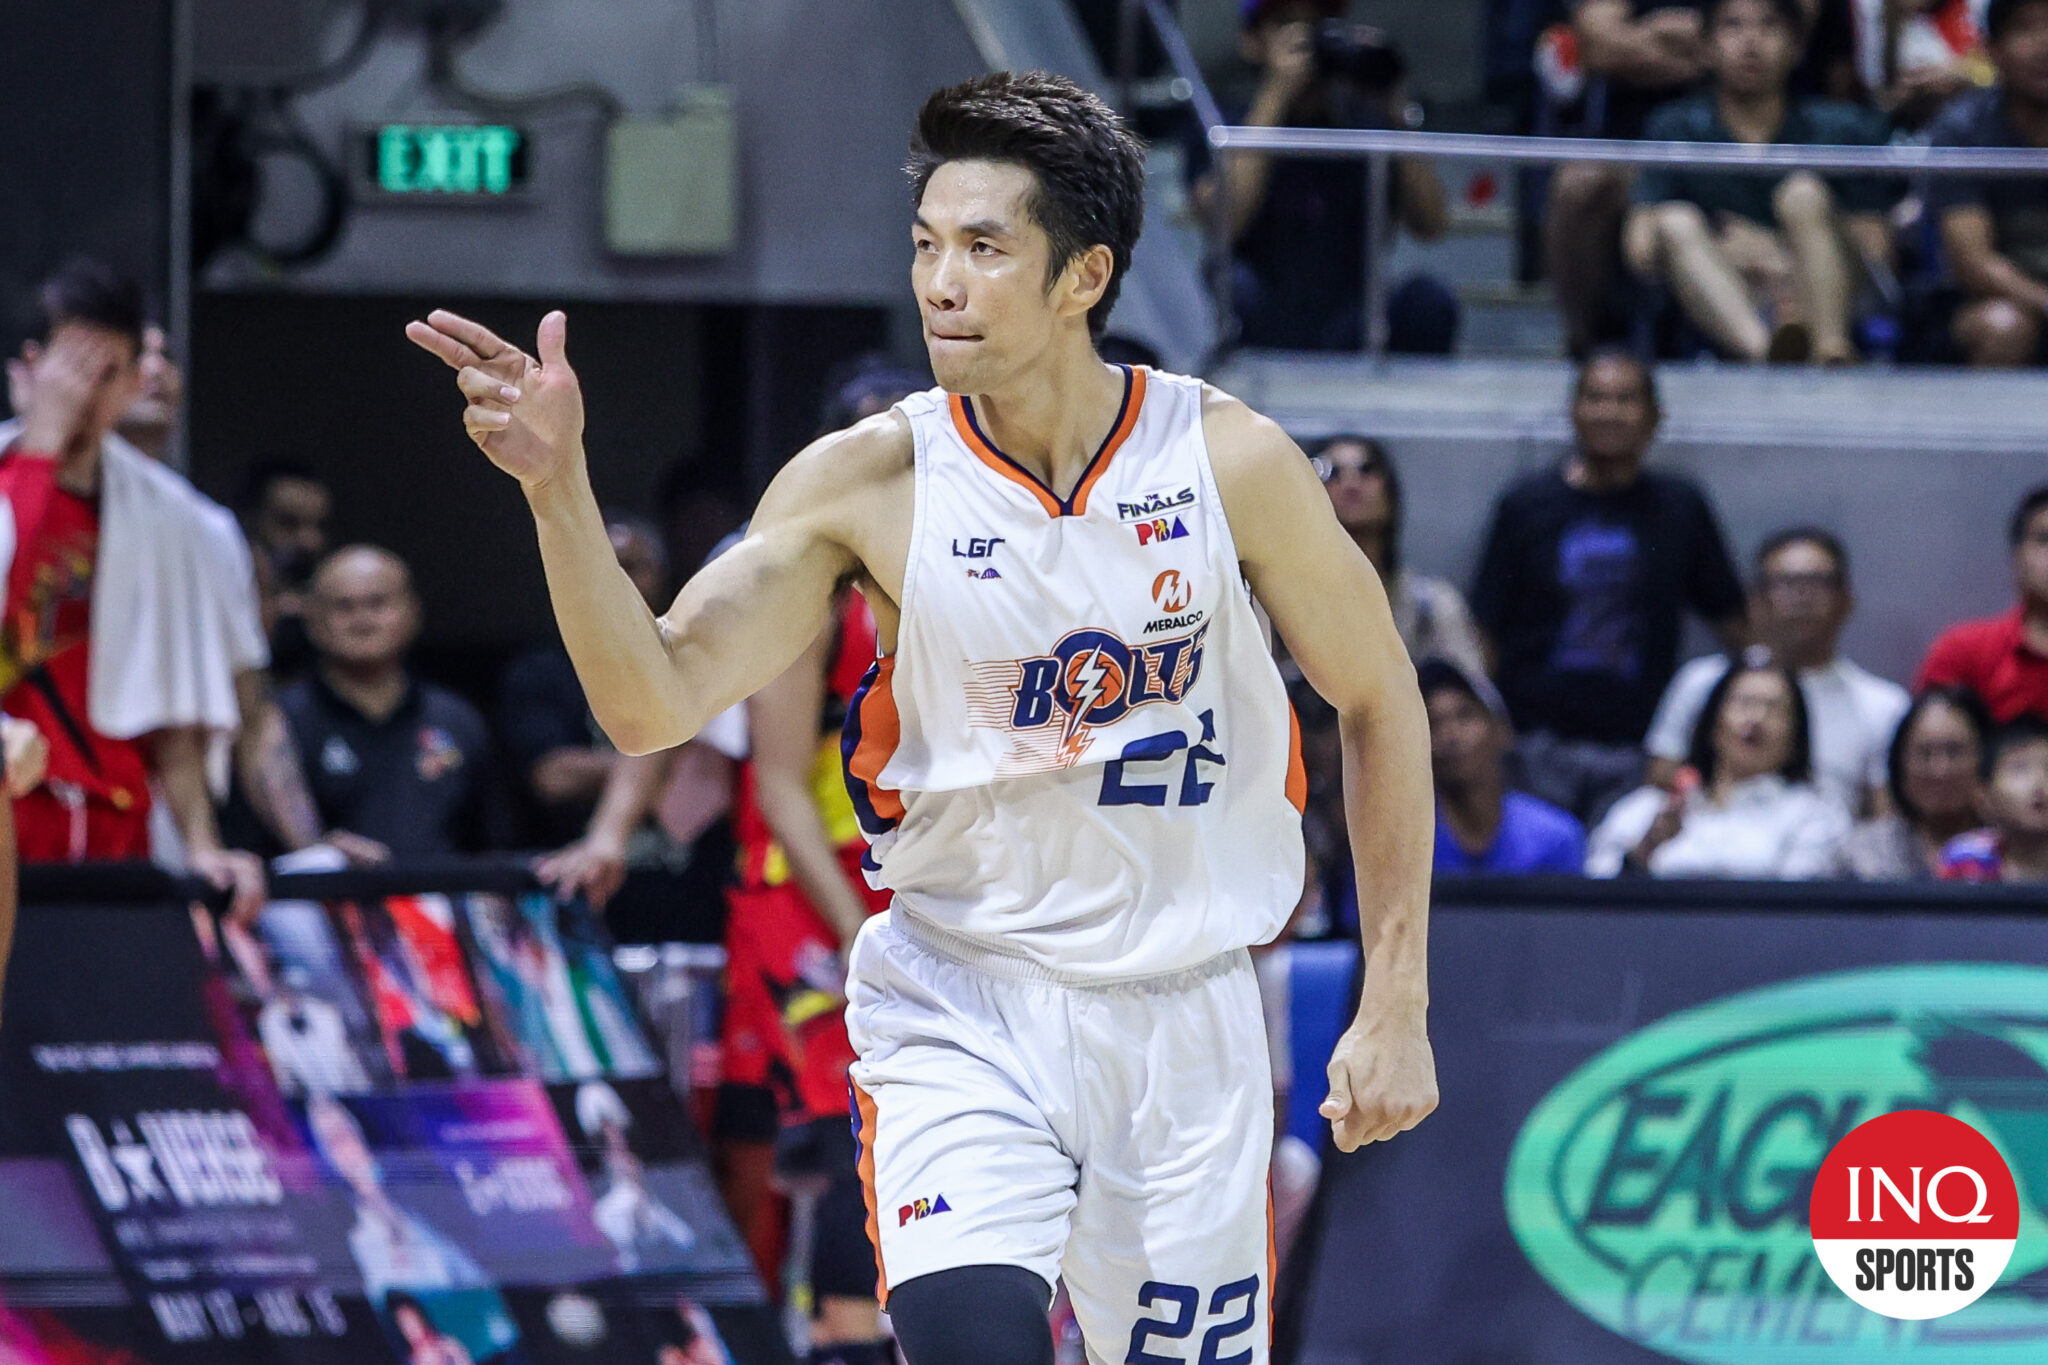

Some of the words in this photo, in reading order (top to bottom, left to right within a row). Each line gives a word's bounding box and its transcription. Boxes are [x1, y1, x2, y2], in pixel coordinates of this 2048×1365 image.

[379, 124, 521, 193] EXIT
[1117, 487, 1195, 520] FINALS
[1145, 493, 1160, 502] THE
[1135, 515, 1190, 546] PBA
[1143, 611, 1203, 635] MERALCO
[1009, 617, 1212, 728] BOLTS
[898, 1193, 953, 1228] PBA
[1124, 1273, 1260, 1365] 22
